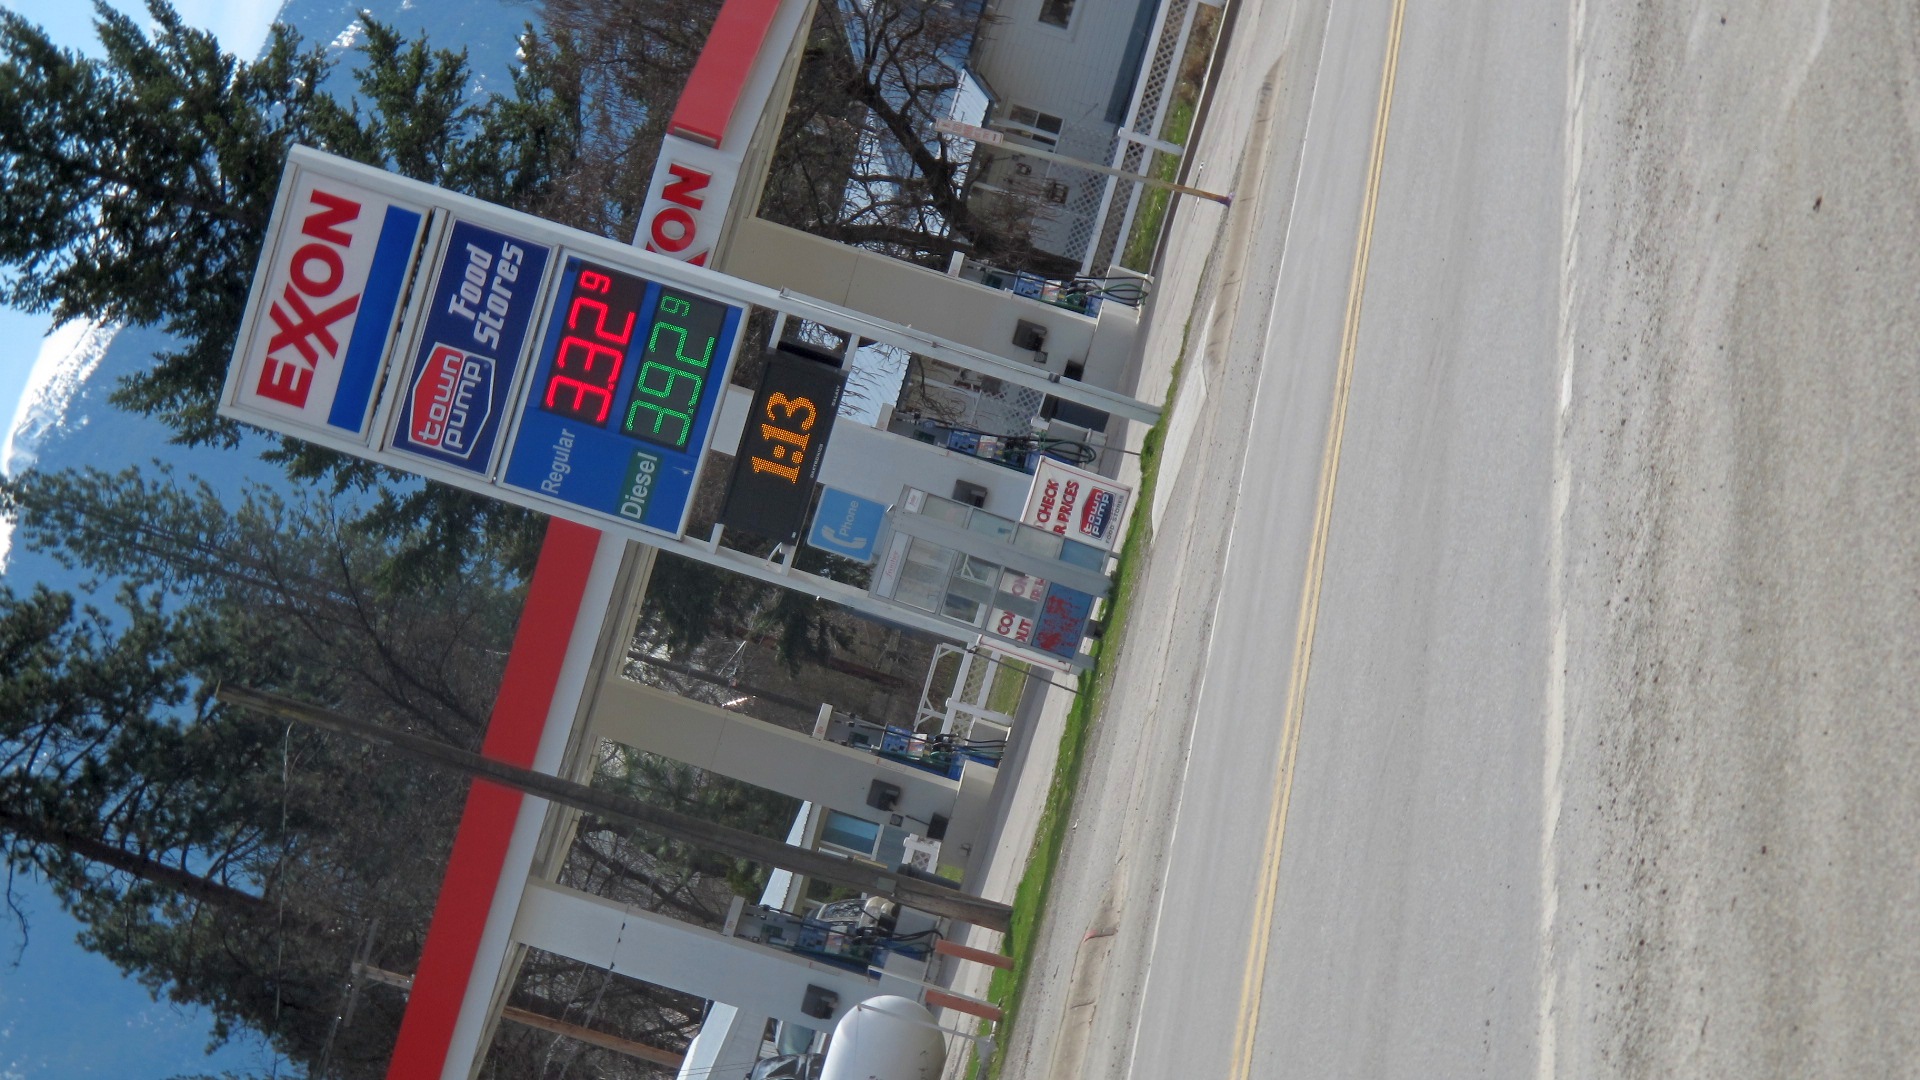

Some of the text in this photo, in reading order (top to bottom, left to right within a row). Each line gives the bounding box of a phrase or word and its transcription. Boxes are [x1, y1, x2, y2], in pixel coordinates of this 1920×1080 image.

[256, 189, 362, 409] EXXON
[448, 243, 493, 321] Food
[473, 241, 523, 350] Stores
[418, 354, 461, 441] town
[444, 361, 482, 448] pump
[541, 428, 575, 494] Regular
[751, 391, 817, 484] 1:13
[620, 452, 658, 520] Diesel
[839, 500, 859, 537] Phone
[1036, 479, 1059, 523] CHECK
[1058, 480, 1079, 523] PRICES
[1083, 490, 1103, 534] town
[1091, 493, 1109, 536] pump
[1105, 496, 1124, 543] FOOD STORES
